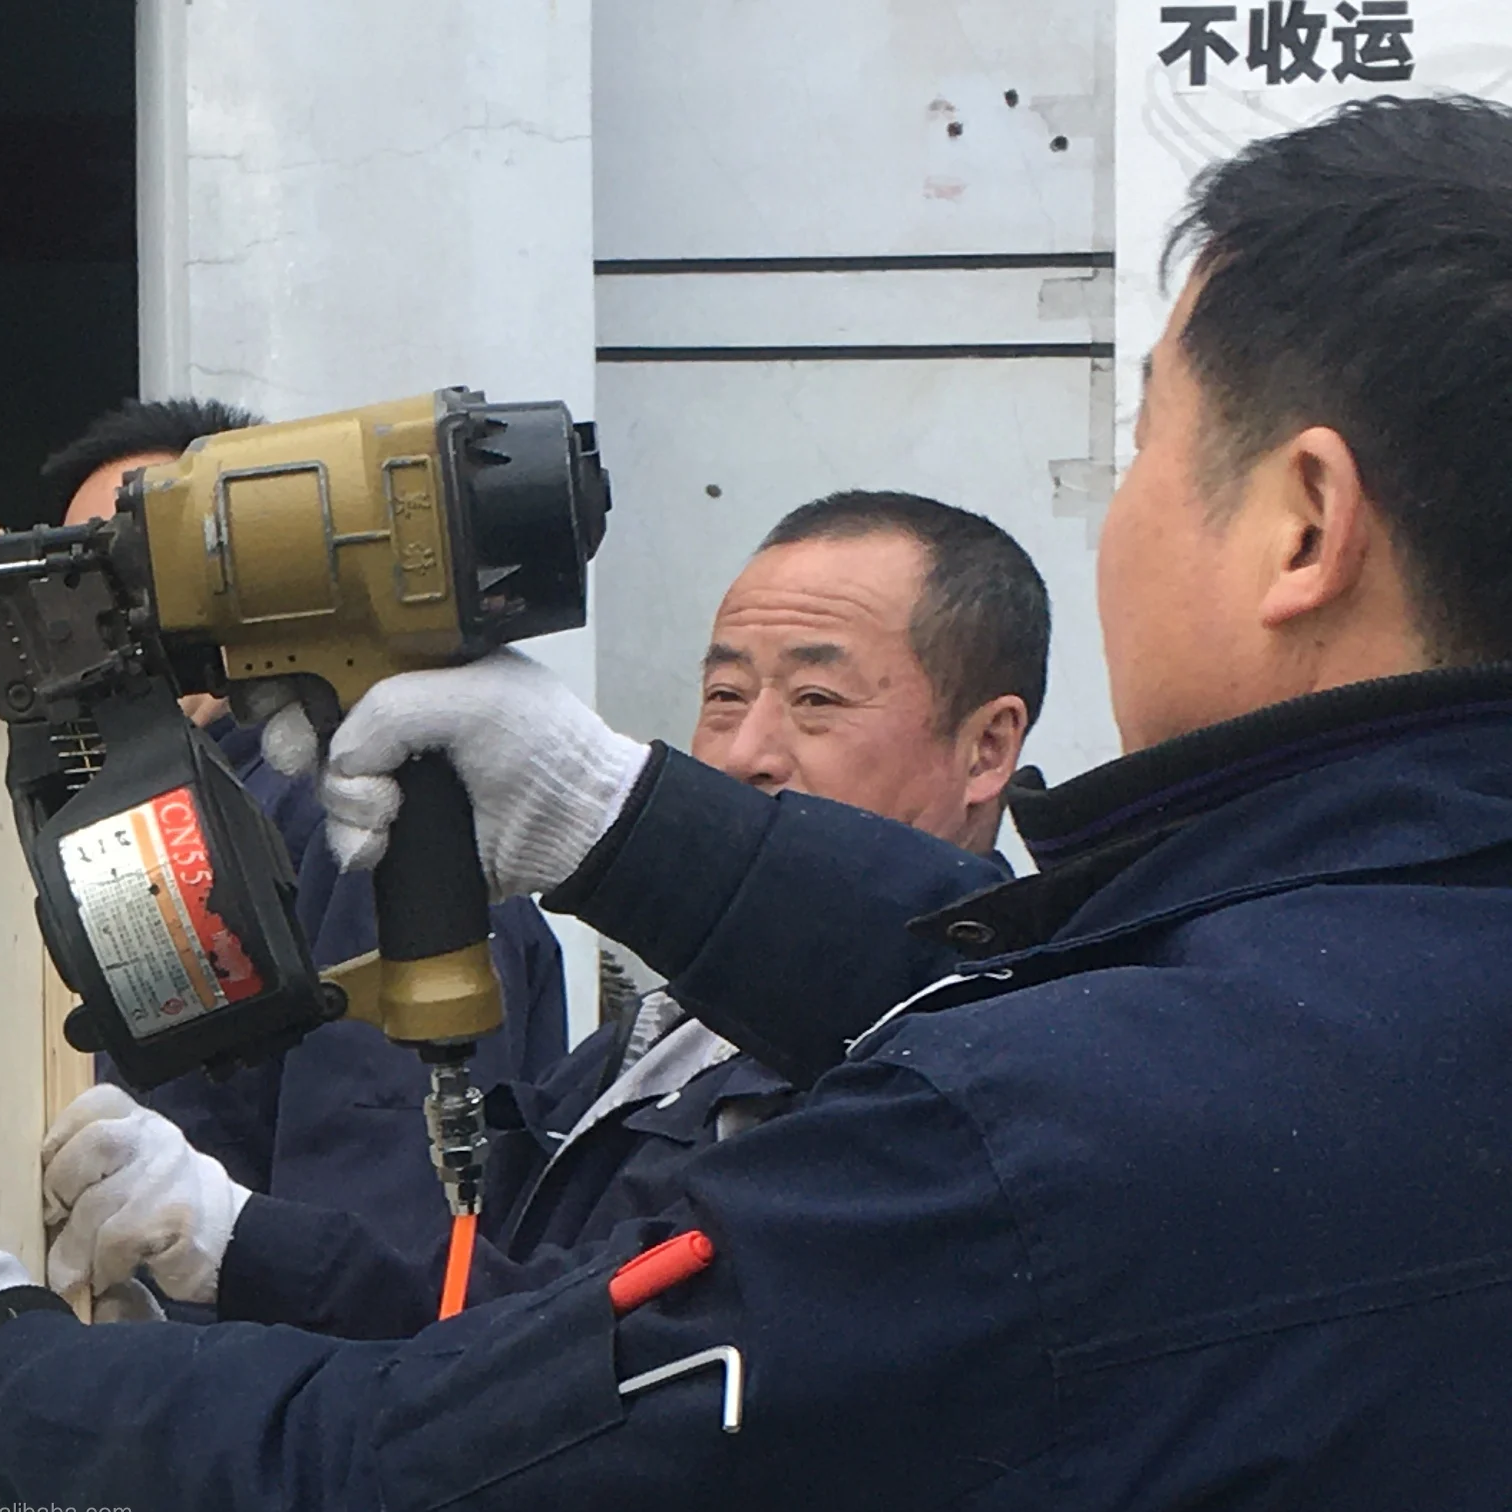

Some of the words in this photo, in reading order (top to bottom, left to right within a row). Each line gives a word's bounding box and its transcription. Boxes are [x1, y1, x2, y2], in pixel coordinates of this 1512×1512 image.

[1157, 0, 1414, 86] 不收运
[160, 802, 213, 885] CN55
